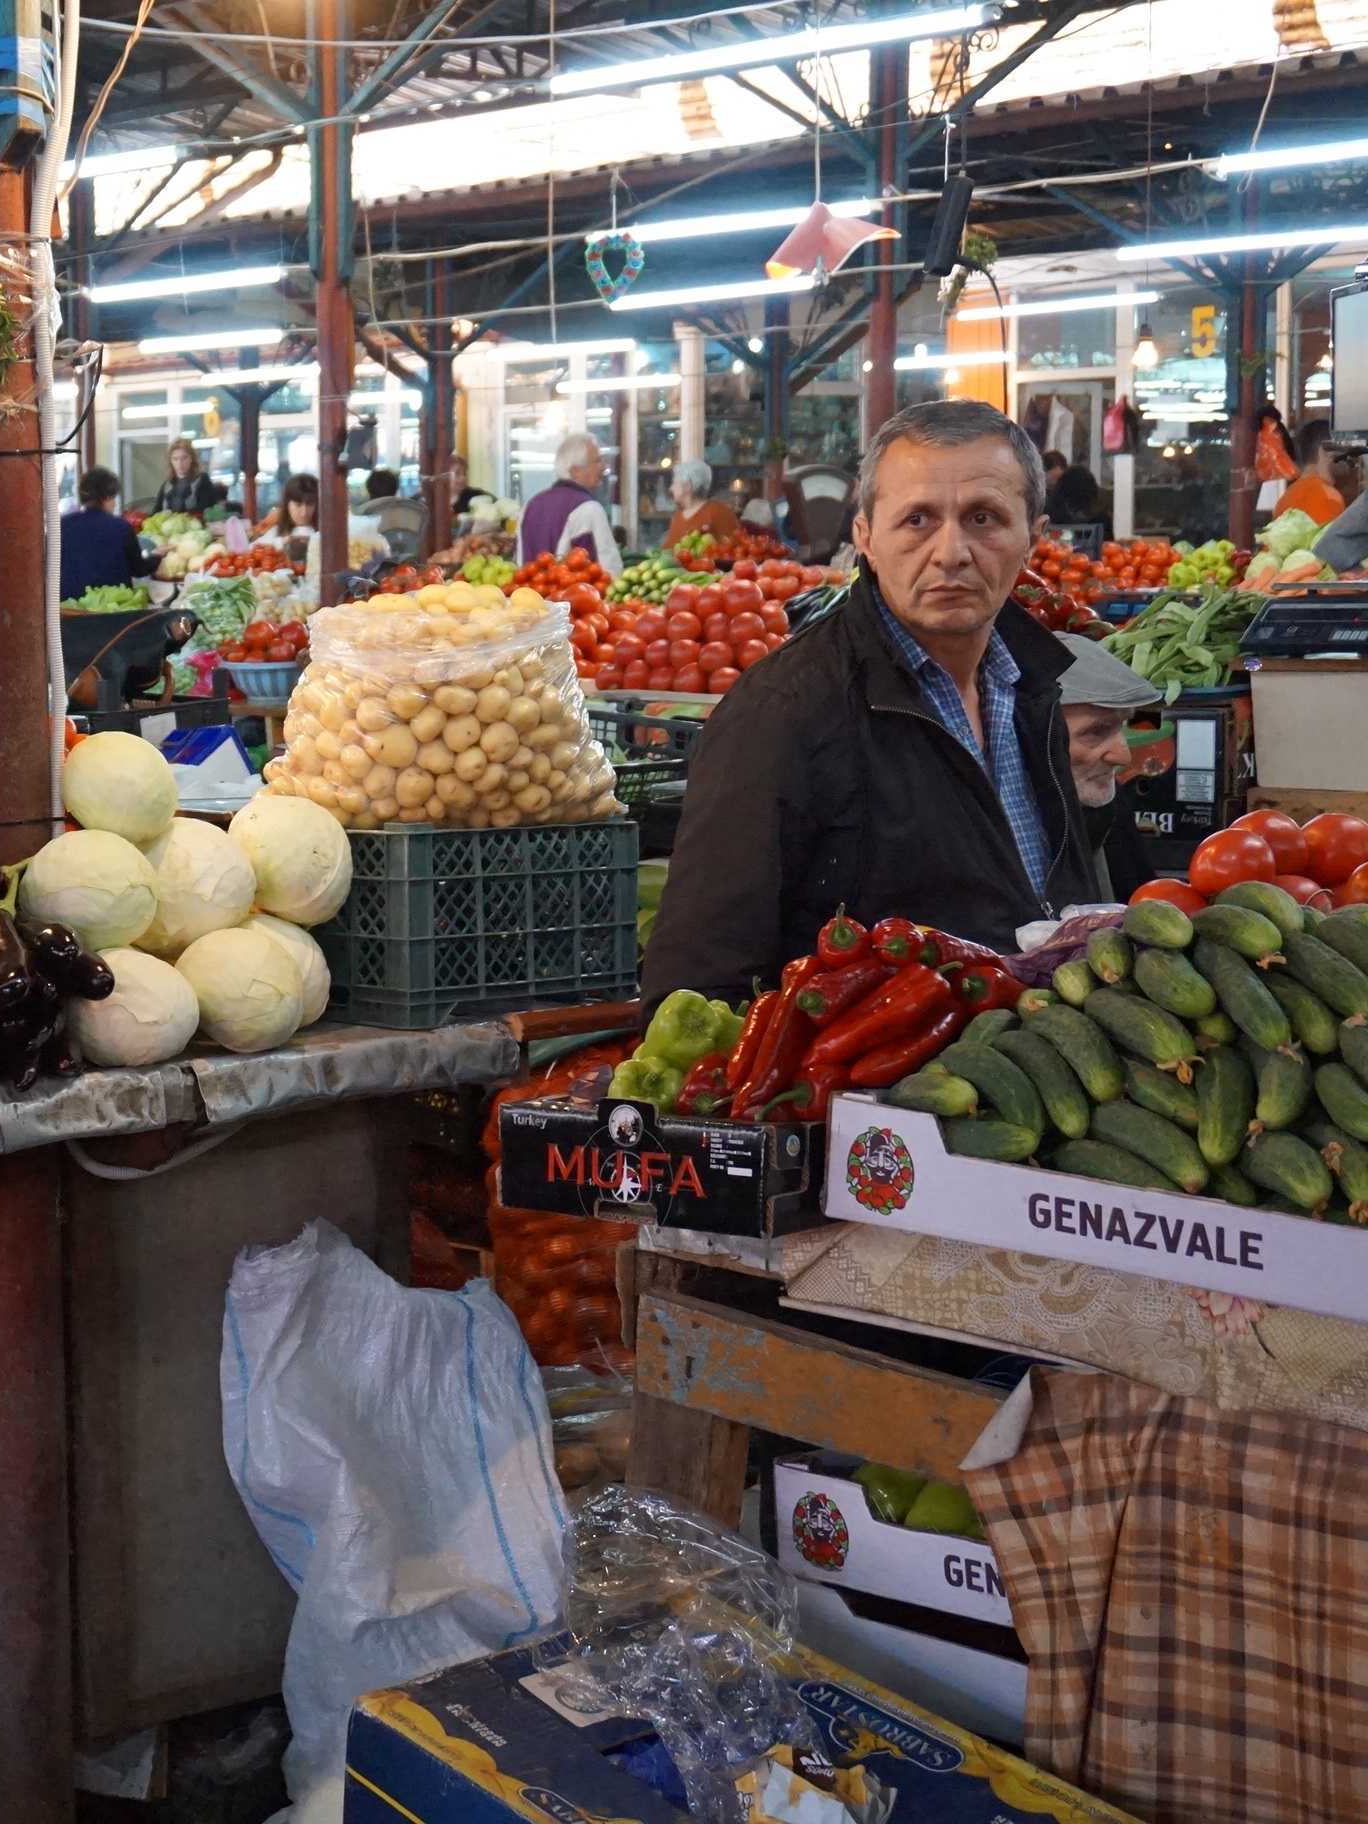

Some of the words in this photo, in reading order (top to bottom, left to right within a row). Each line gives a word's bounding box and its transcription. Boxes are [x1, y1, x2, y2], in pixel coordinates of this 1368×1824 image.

[1191, 305, 1216, 358] 5
[511, 1112, 548, 1130] Turkey
[1028, 1192, 1265, 1271] GENAZVALE
[943, 1553, 1006, 1599] GEN
[808, 1684, 952, 1767] SABROSTAR
